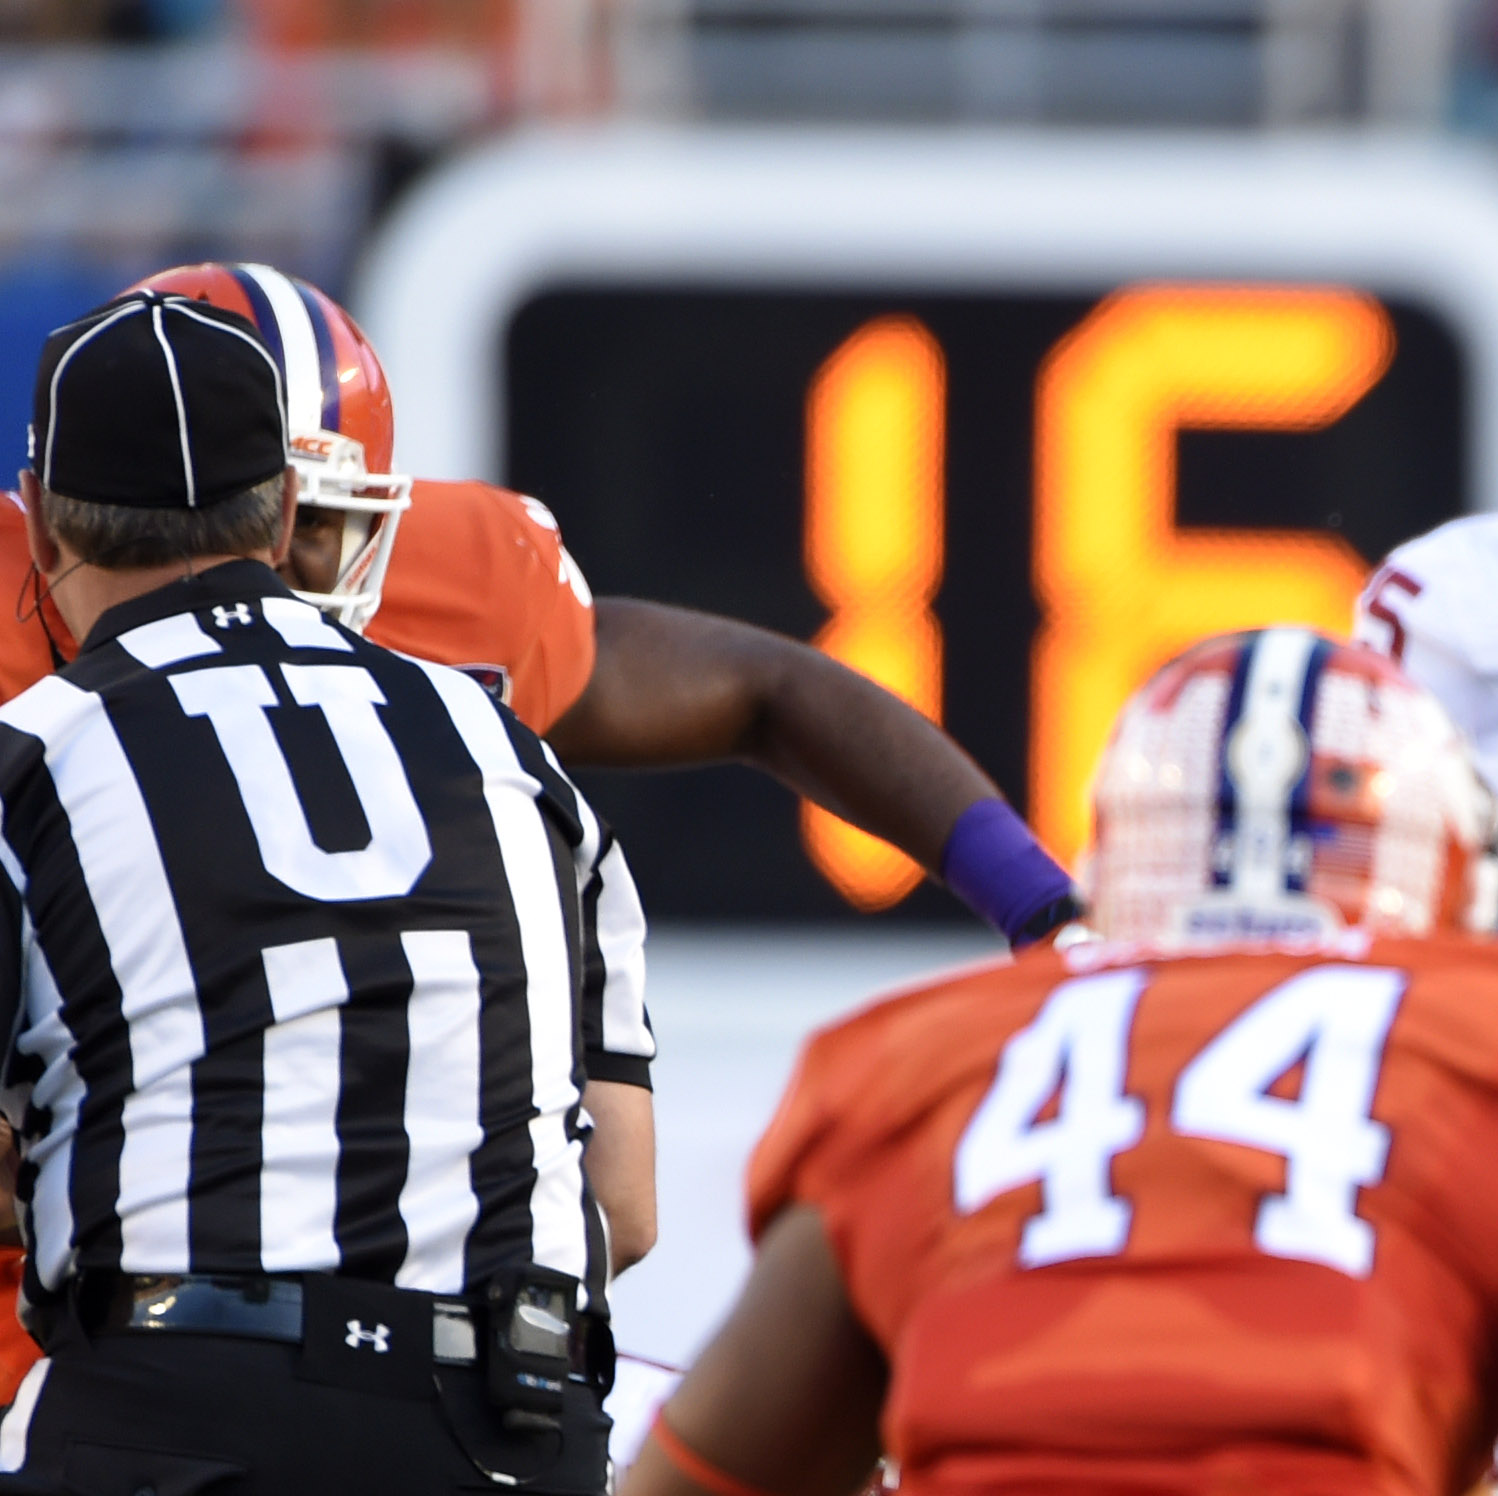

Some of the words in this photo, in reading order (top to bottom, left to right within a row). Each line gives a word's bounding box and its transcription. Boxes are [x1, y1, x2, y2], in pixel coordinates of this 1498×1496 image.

[803, 282, 1398, 912] 16
[168, 662, 433, 902] U
[954, 964, 1406, 1280] 44
